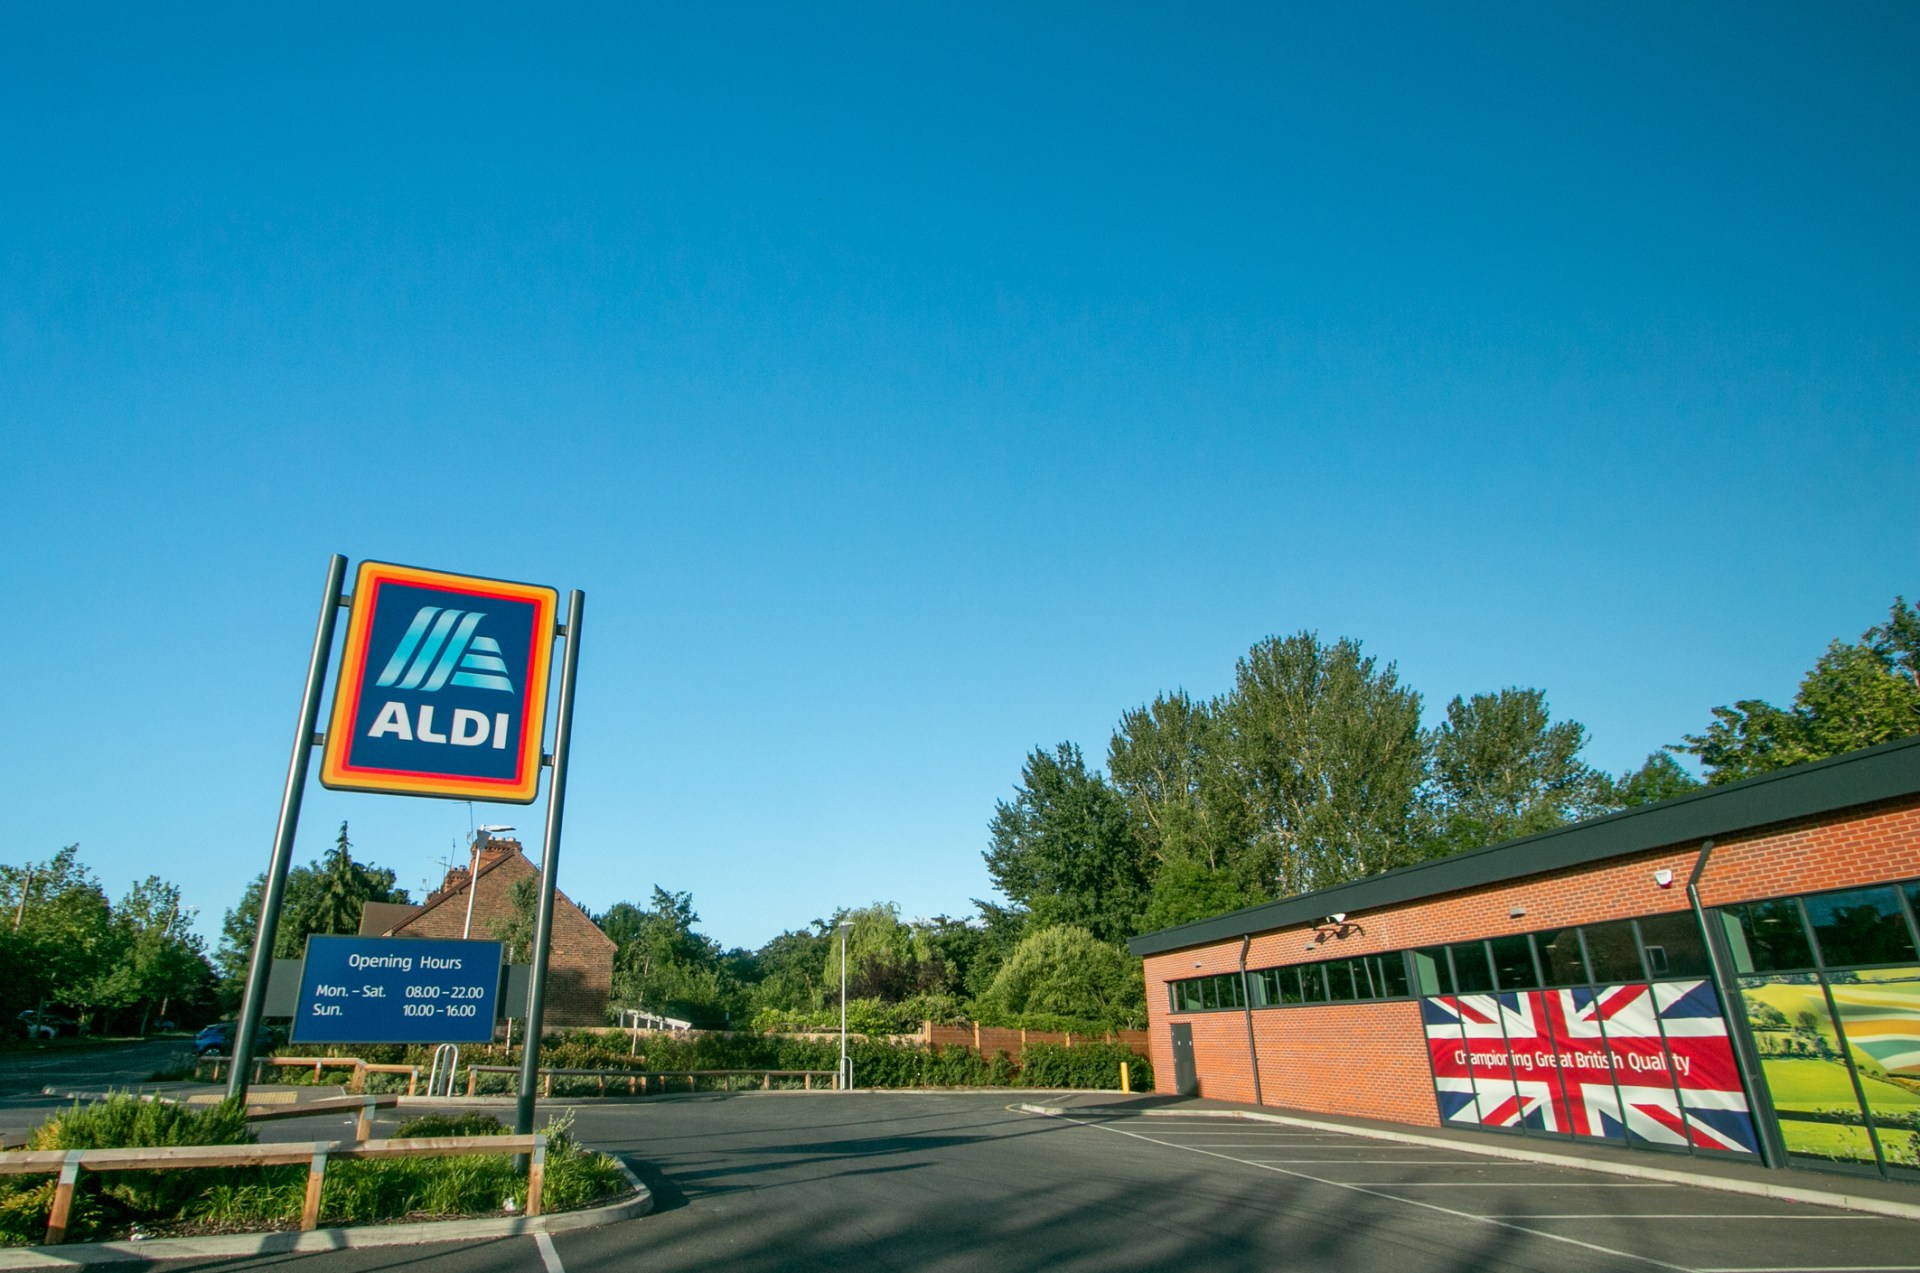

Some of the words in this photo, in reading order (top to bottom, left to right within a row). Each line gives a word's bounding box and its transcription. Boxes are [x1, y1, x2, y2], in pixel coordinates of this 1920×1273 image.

[367, 701, 510, 750] ALDI
[348, 953, 413, 972] Opening
[420, 956, 462, 970] Hours
[315, 984, 349, 998] Mon.
[362, 984, 386, 998] Sat.
[312, 1003, 343, 1017] Sun.
[1535, 1050, 1575, 1069] Great
[1574, 1050, 1625, 1070] British
[1627, 1051, 1690, 1076] Qualty
